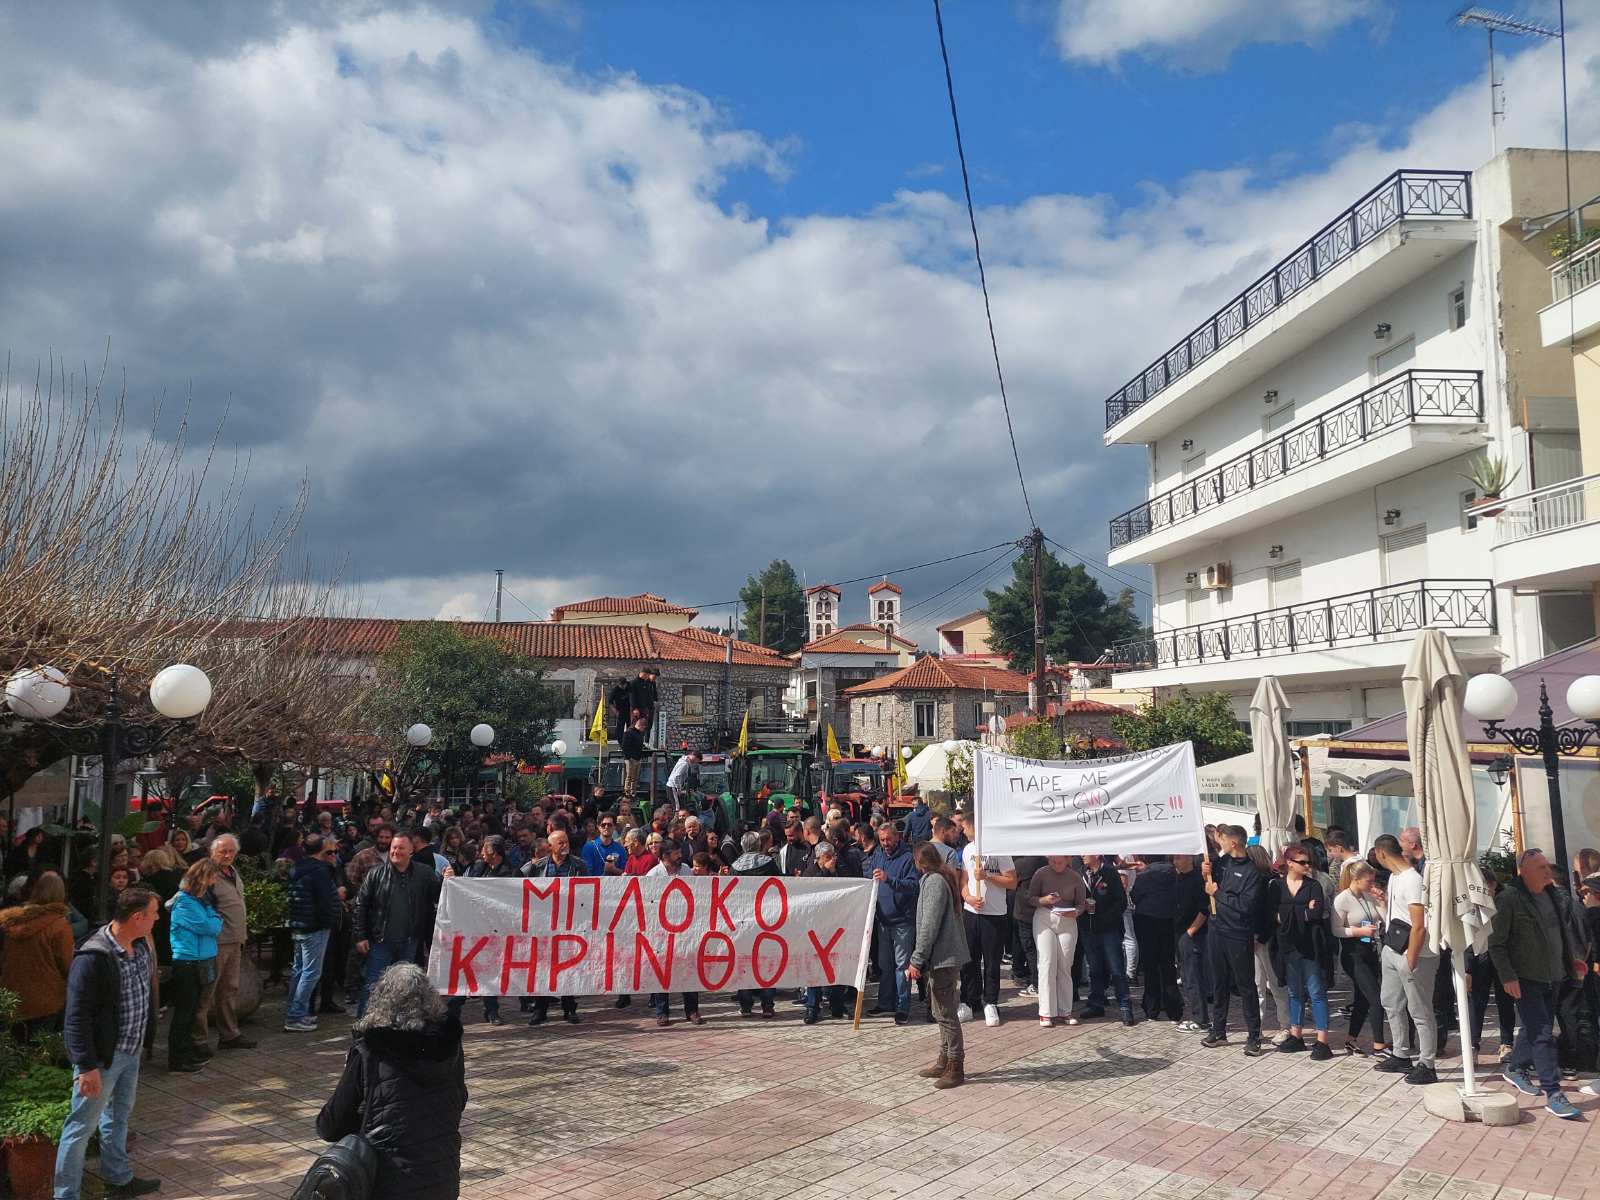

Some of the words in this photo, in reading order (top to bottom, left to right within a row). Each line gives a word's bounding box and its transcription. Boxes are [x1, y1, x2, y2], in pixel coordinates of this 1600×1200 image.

[1009, 775, 1062, 792] ΠΑΡΕ
[1079, 770, 1108, 786] ΜΕ
[521, 877, 789, 933] ΜΠΛΟΚΟ
[448, 927, 845, 995] ΚΗΡΙΝΘΟΥ
